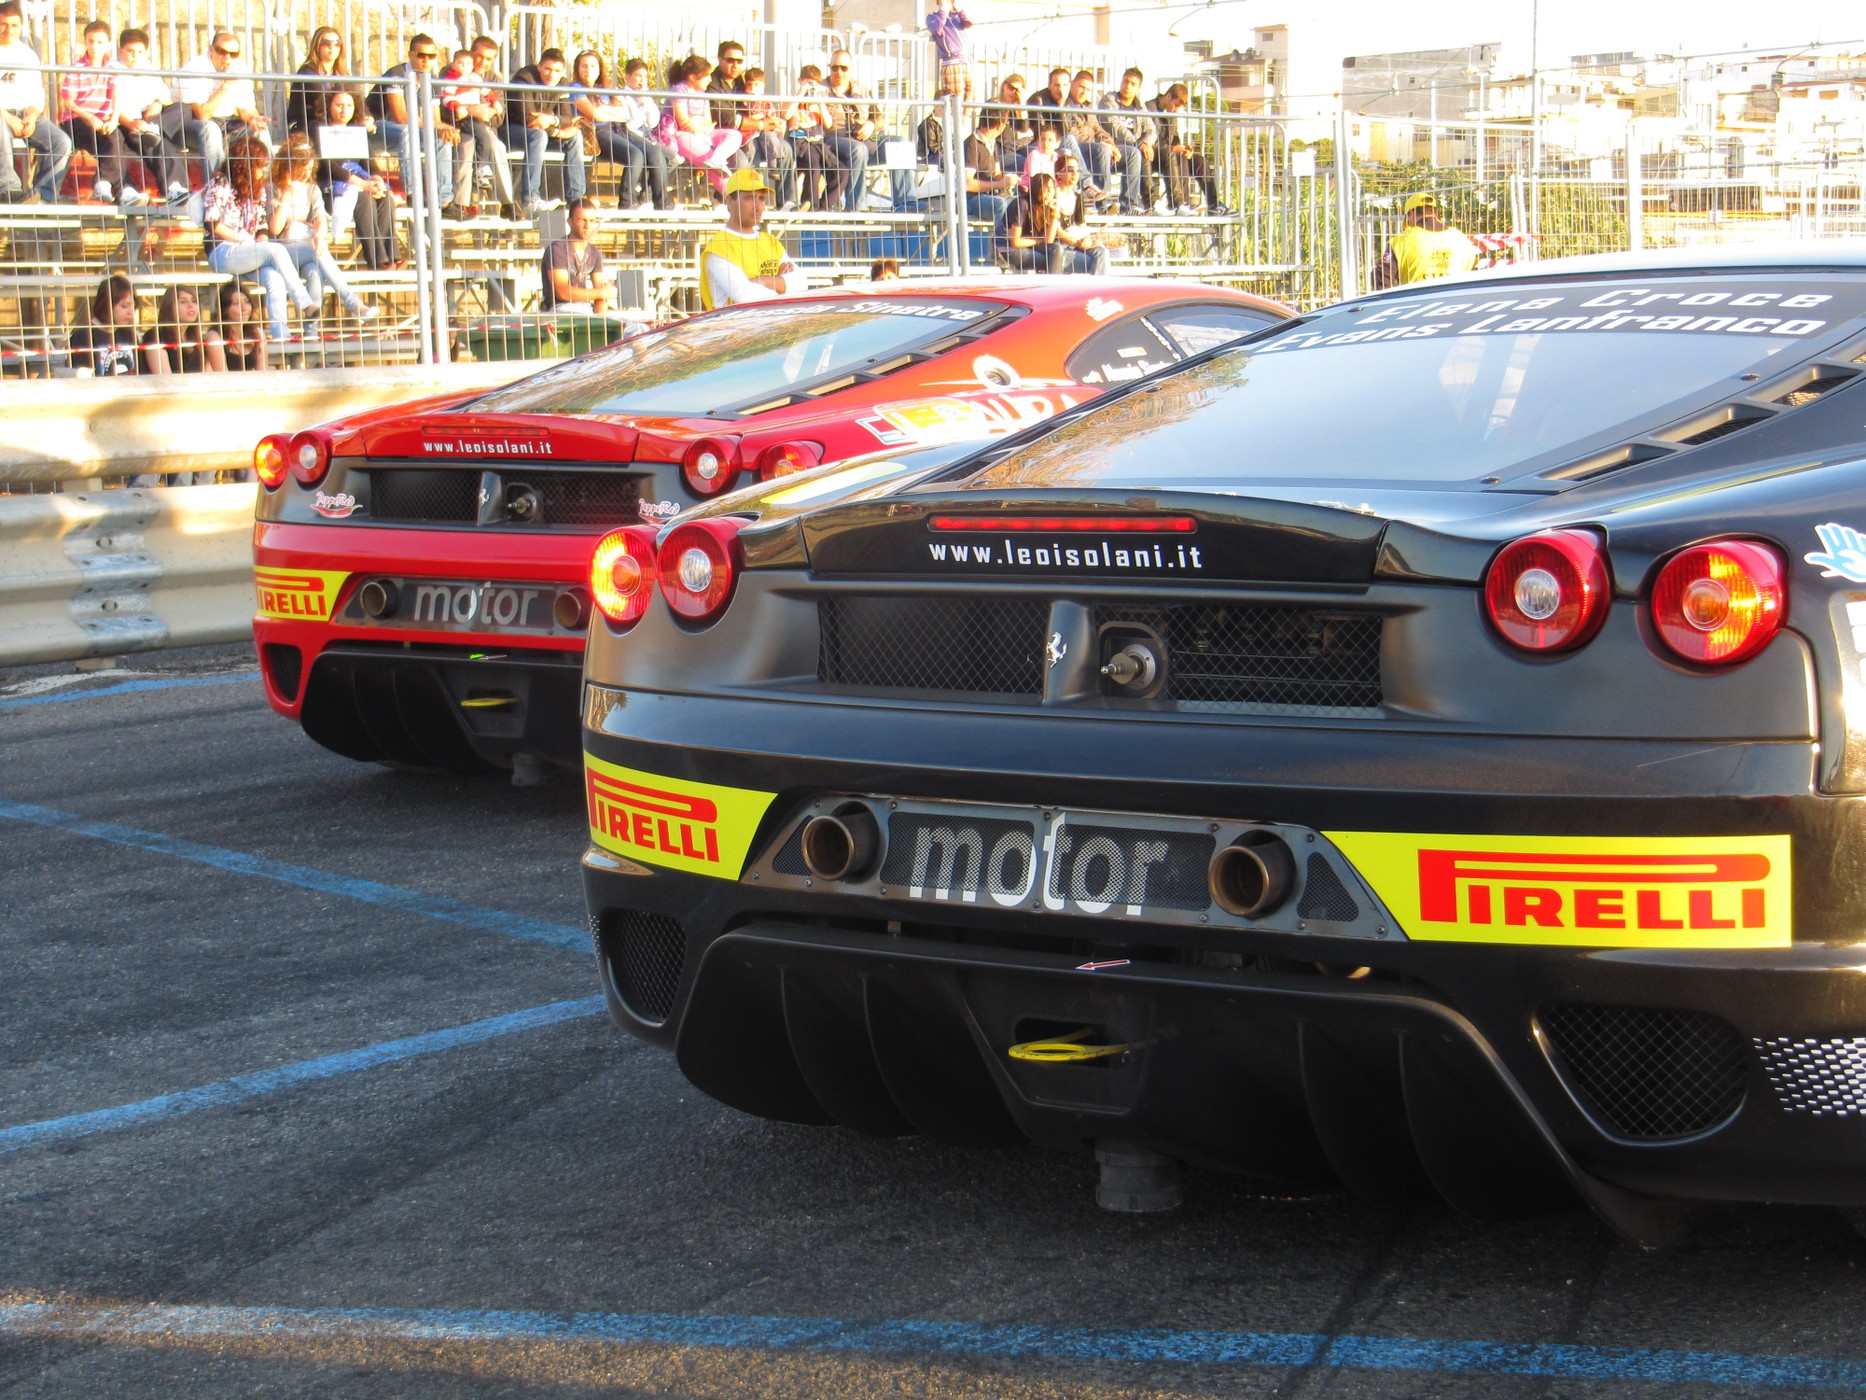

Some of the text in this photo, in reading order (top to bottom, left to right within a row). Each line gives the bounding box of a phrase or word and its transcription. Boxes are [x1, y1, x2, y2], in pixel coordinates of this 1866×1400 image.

[835, 301, 985, 321] Sinatra
[1354, 289, 1833, 325] Elena Croce
[1254, 309, 1827, 354] Evans Lanfranco
[423, 440, 553, 454] www.leoisolani.it
[928, 539, 1203, 568] www.leoisolani.it
[414, 581, 539, 626] motor
[586, 765, 720, 863] PIRELLI
[909, 811, 1170, 916] motor
[1417, 849, 1771, 929] PIRELLI
